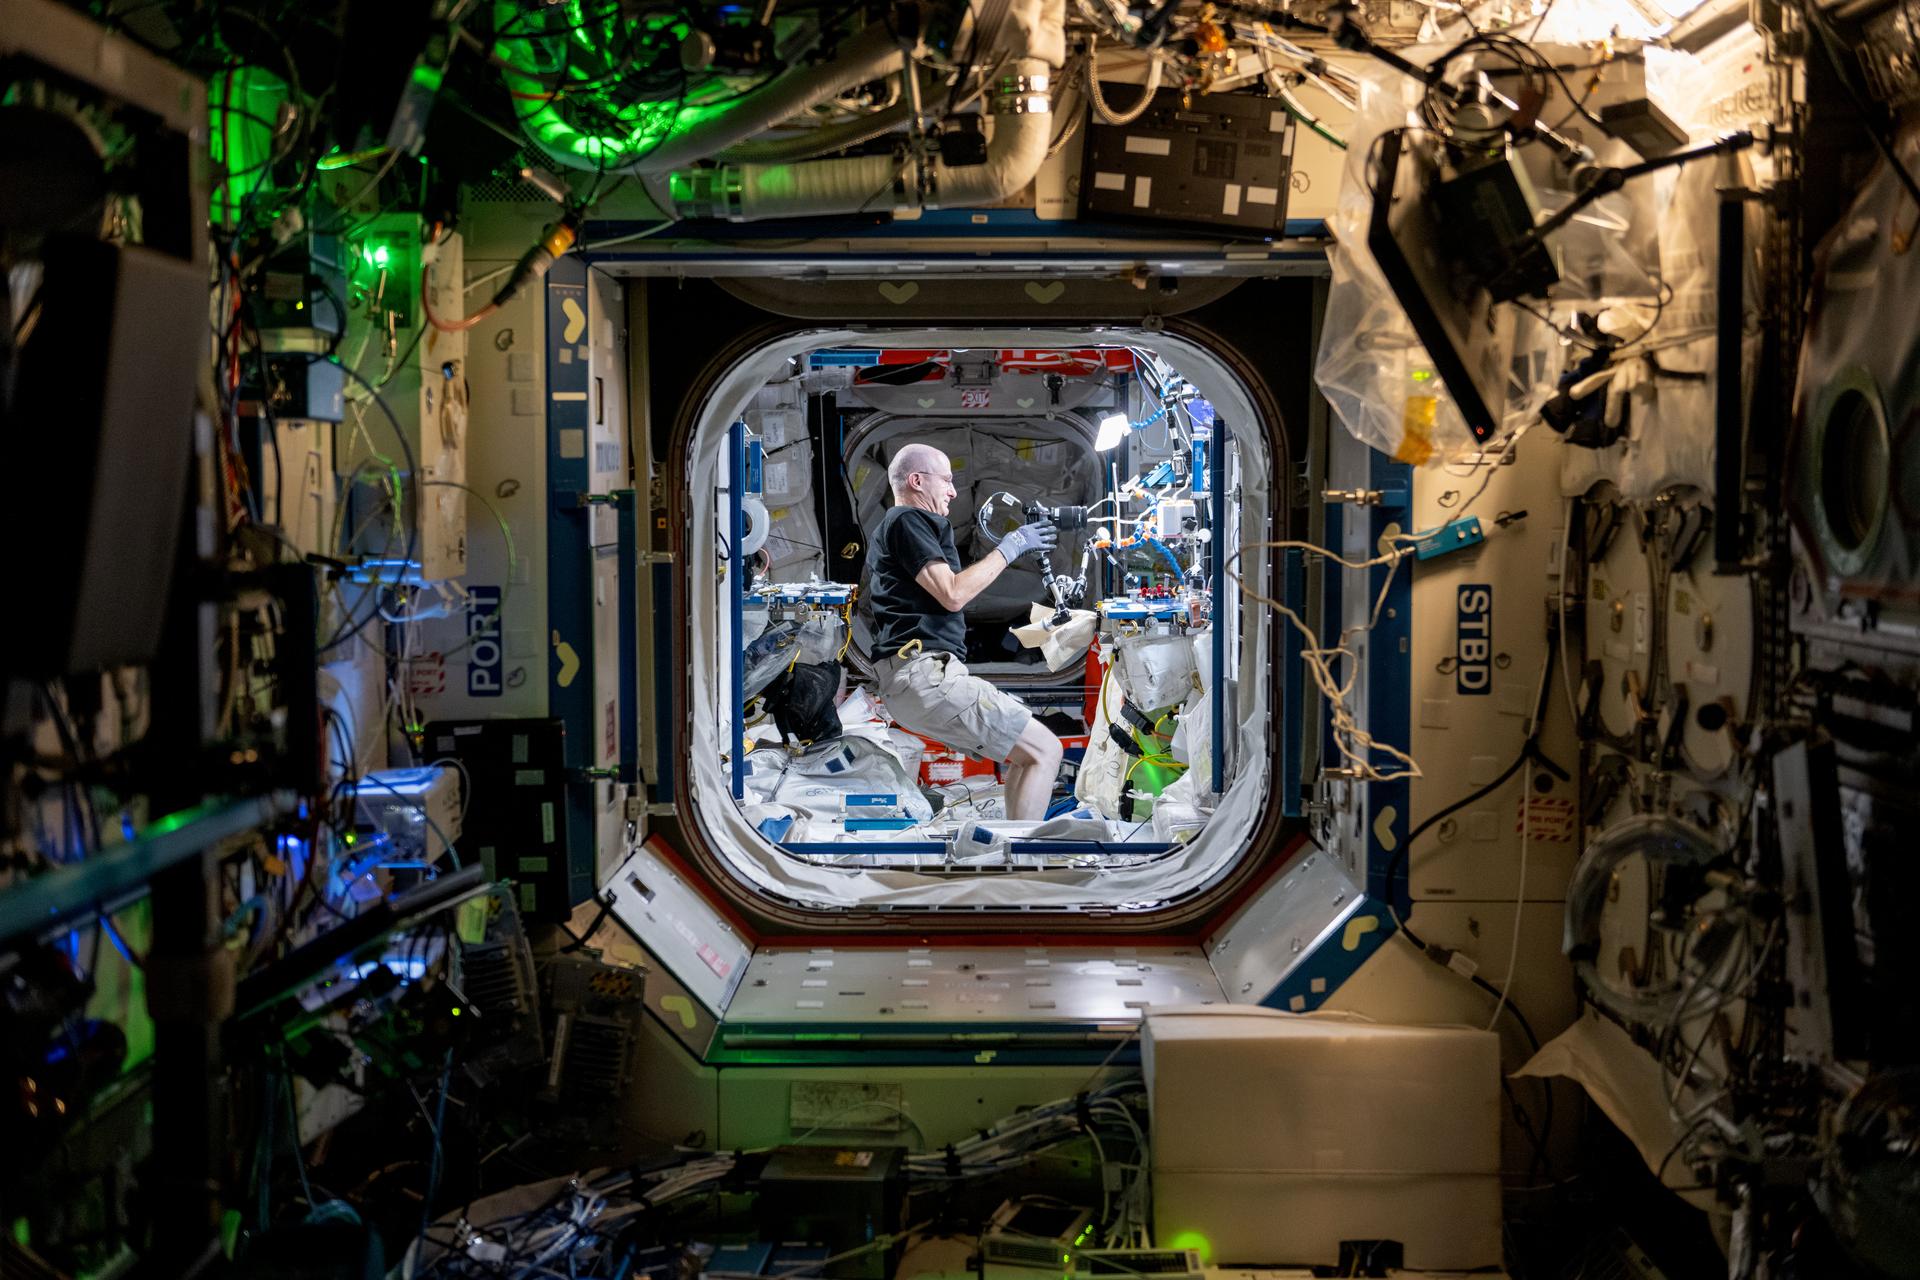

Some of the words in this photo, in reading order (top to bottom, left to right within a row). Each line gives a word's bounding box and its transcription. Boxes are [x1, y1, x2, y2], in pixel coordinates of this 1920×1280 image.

[967, 391, 985, 403] EXIT
[470, 590, 500, 691] PORT
[1459, 590, 1489, 689] STBD
